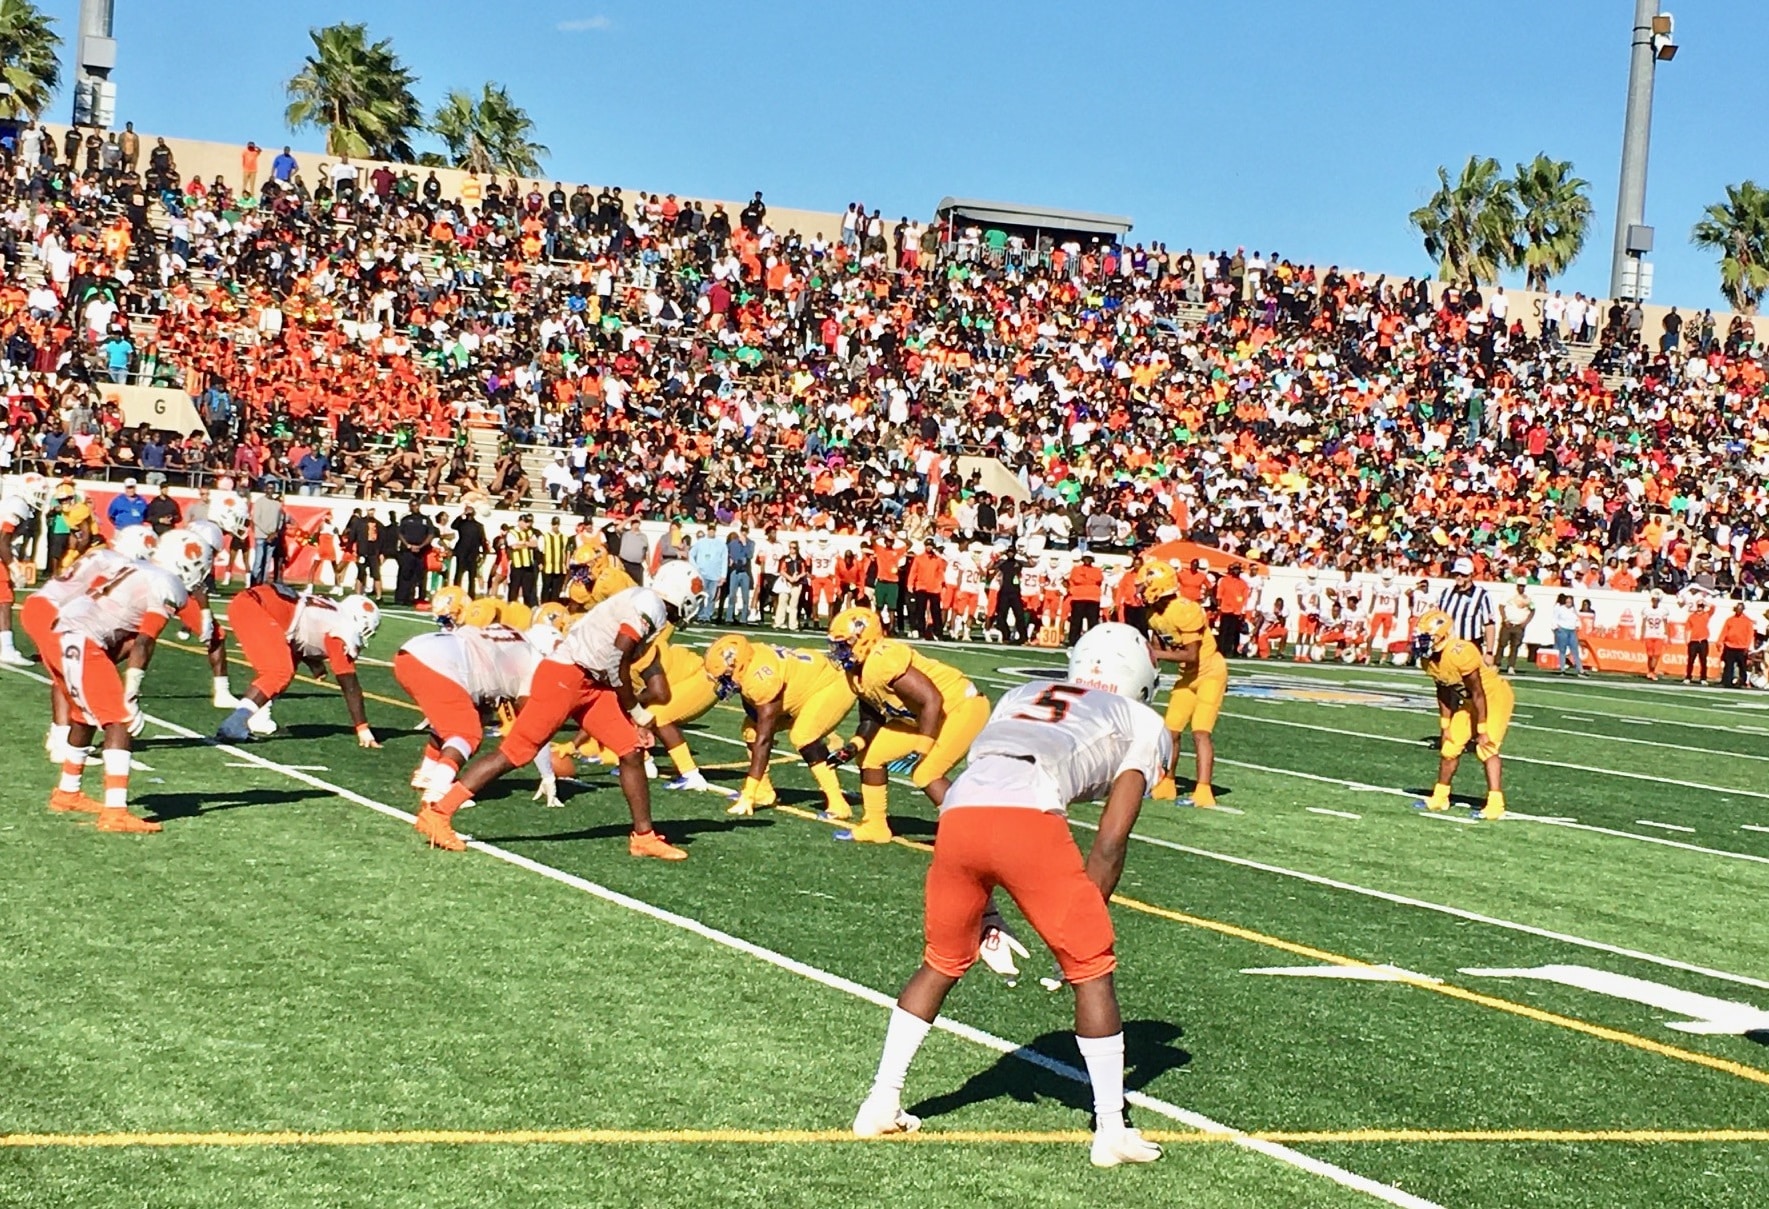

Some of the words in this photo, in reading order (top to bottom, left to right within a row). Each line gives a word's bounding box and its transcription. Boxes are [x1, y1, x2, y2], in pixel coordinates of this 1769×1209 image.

[154, 399, 166, 415] G
[966, 570, 979, 583] 20
[1042, 629, 1057, 643] 30
[1597, 648, 1648, 663] GATORAD
[753, 665, 773, 681] 78
[1011, 684, 1090, 723] 5
